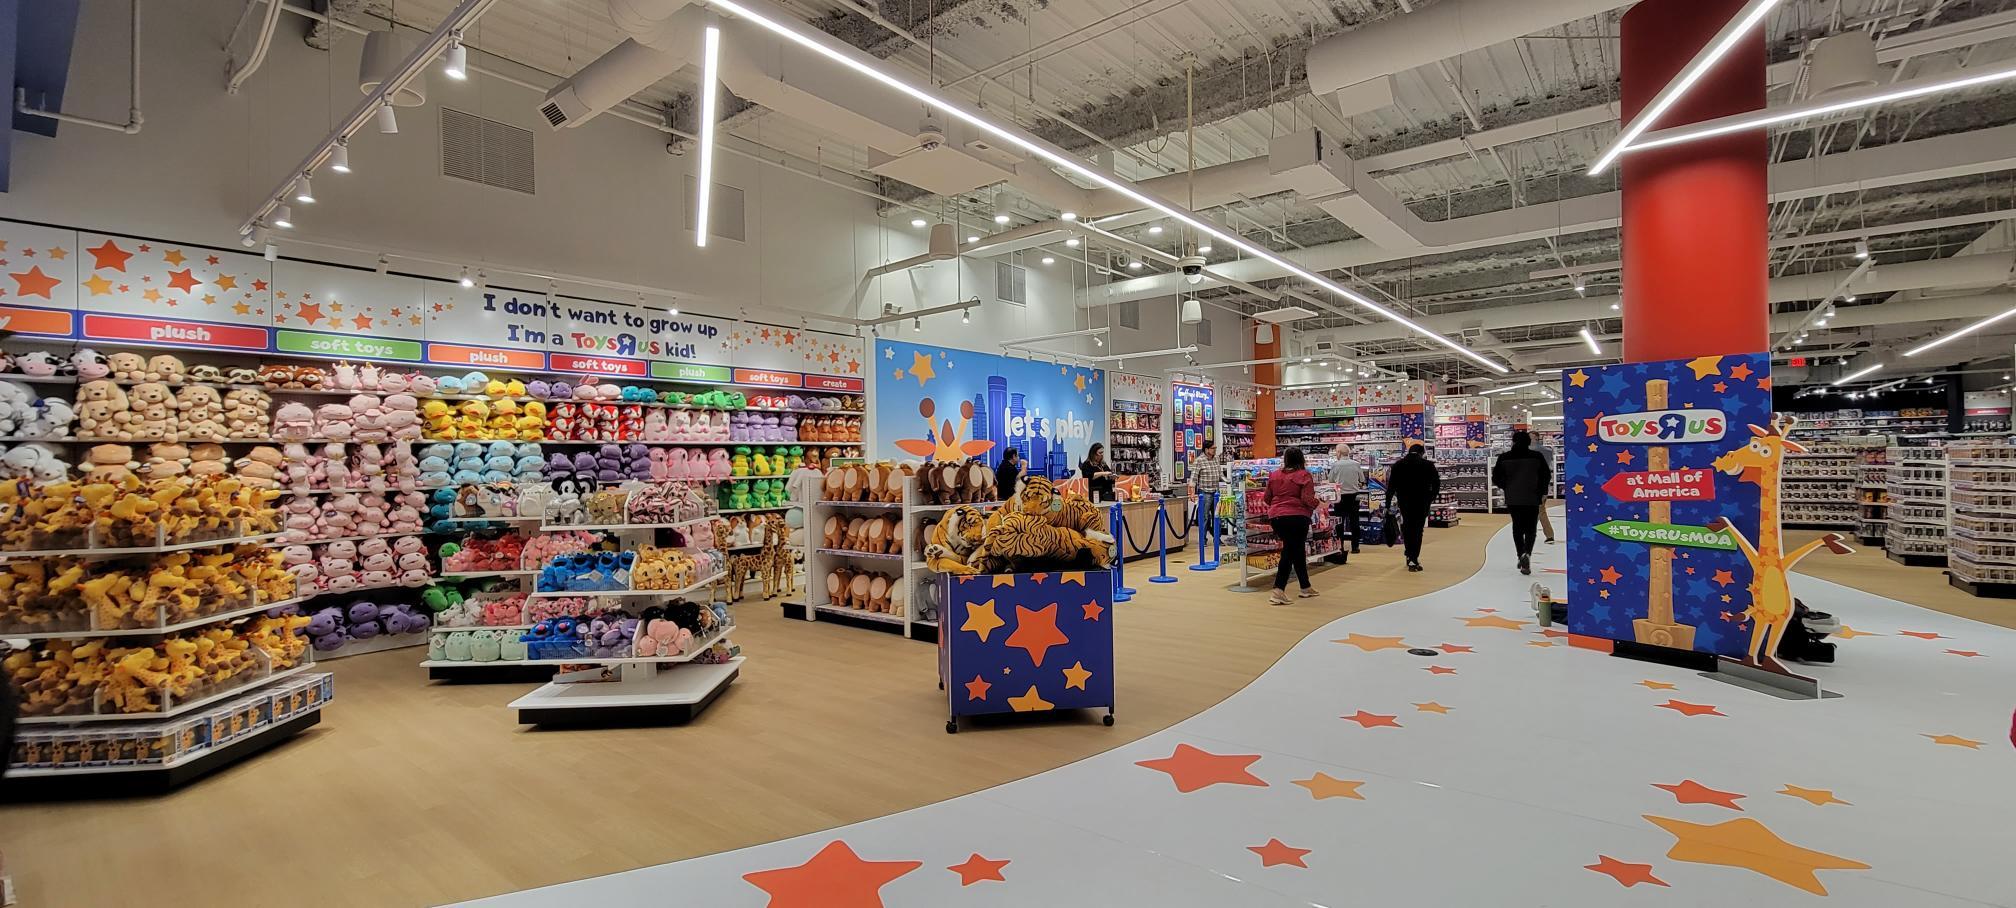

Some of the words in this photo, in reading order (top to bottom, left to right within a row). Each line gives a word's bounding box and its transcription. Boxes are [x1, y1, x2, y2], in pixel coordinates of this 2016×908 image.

[484, 293, 497, 312] I
[503, 297, 561, 319] don't
[568, 305, 617, 324] want
[623, 310, 645, 328] to
[649, 317, 694, 339] grow
[698, 322, 718, 339] up
[151, 325, 210, 342] plush
[507, 324, 546, 345] I'm
[551, 332, 564, 346] a
[665, 340, 697, 359] kid!
[311, 338, 350, 352] soft
[355, 341, 393, 355] toys
[469, 350, 508, 366] plush
[571, 358, 598, 372] soft
[601, 360, 628, 374] toys
[678, 366, 706, 379] plush
[749, 372, 767, 383] soft
[769, 373, 789, 385] toys
[822, 379, 848, 389] create
[1005, 407, 1050, 438] let's
[1056, 411, 1094, 445] play
[1626, 475, 1644, 486] at
[1647, 473, 1680, 485] Mall
[1683, 471, 1703, 483] of
[1633, 486, 1700, 498] America
